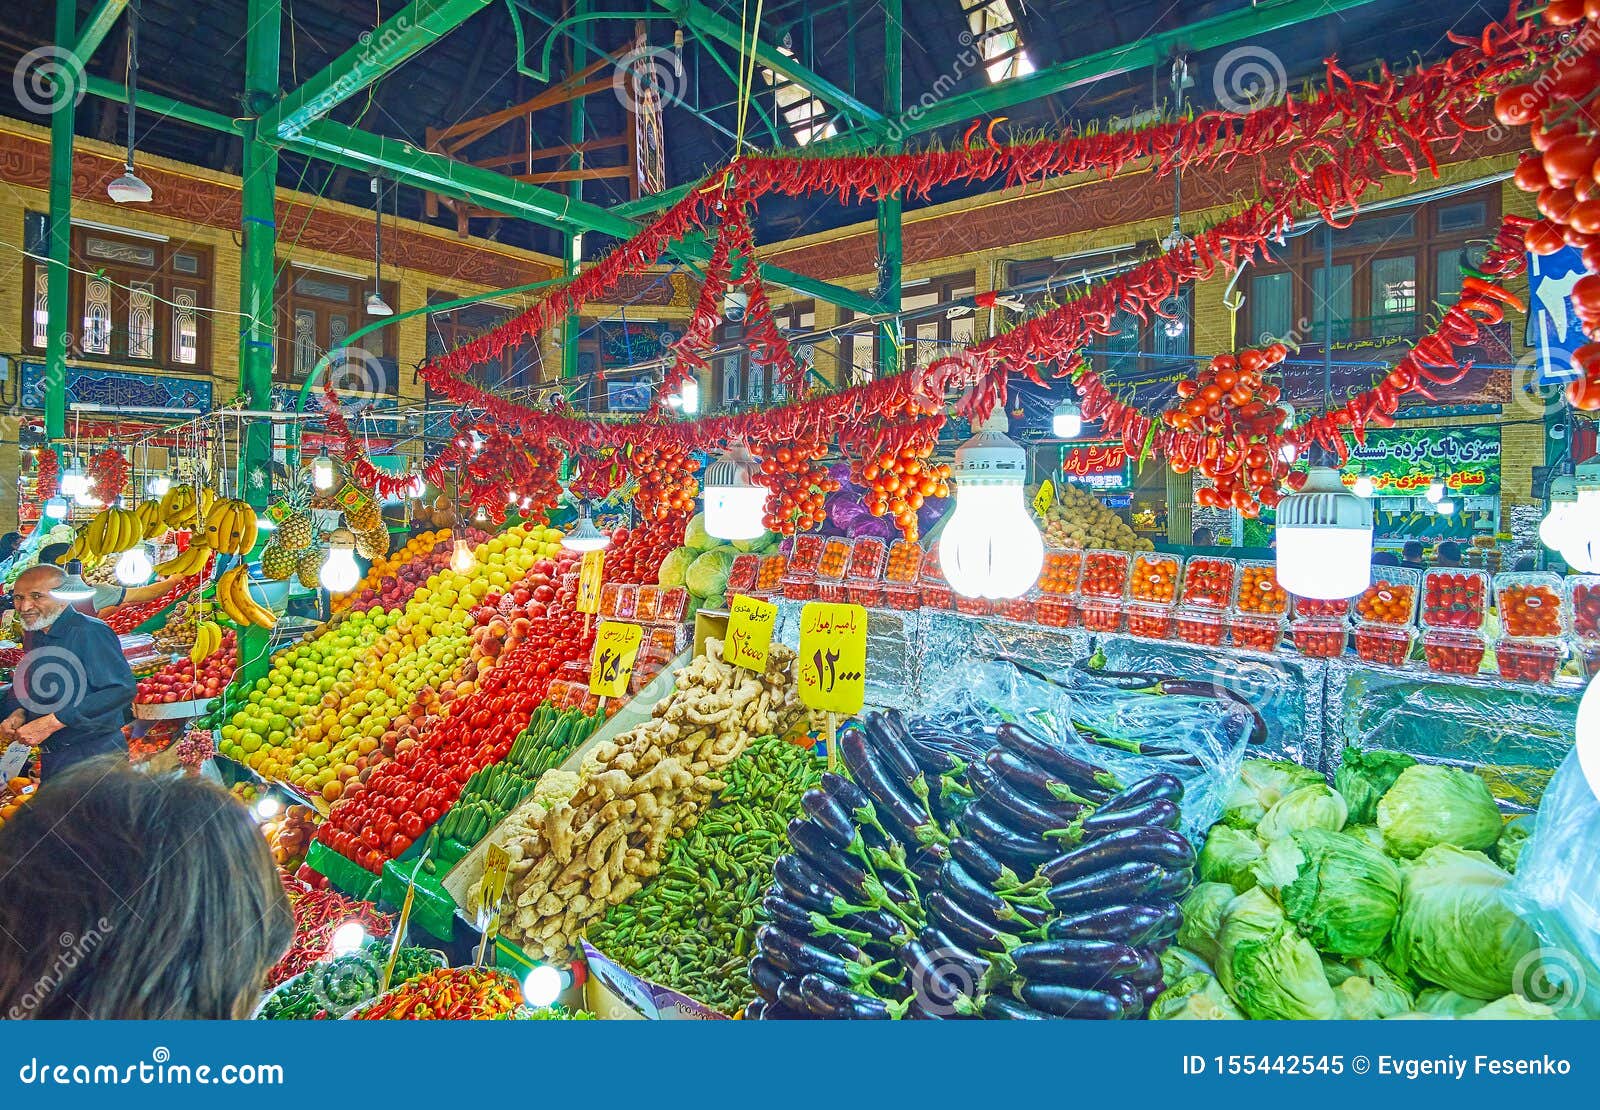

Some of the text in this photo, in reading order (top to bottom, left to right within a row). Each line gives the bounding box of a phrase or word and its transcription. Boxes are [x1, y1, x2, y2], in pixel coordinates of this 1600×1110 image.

[1076, 446, 1126, 476] آرایش
[1430, 437, 1457, 464] پاک
[1460, 439, 1500, 464] سبزی
[1068, 475, 1122, 486] BARBER
[806, 610, 857, 634] بامیه اهواز
[813, 648, 861, 692] ۱۲۰۰۰
